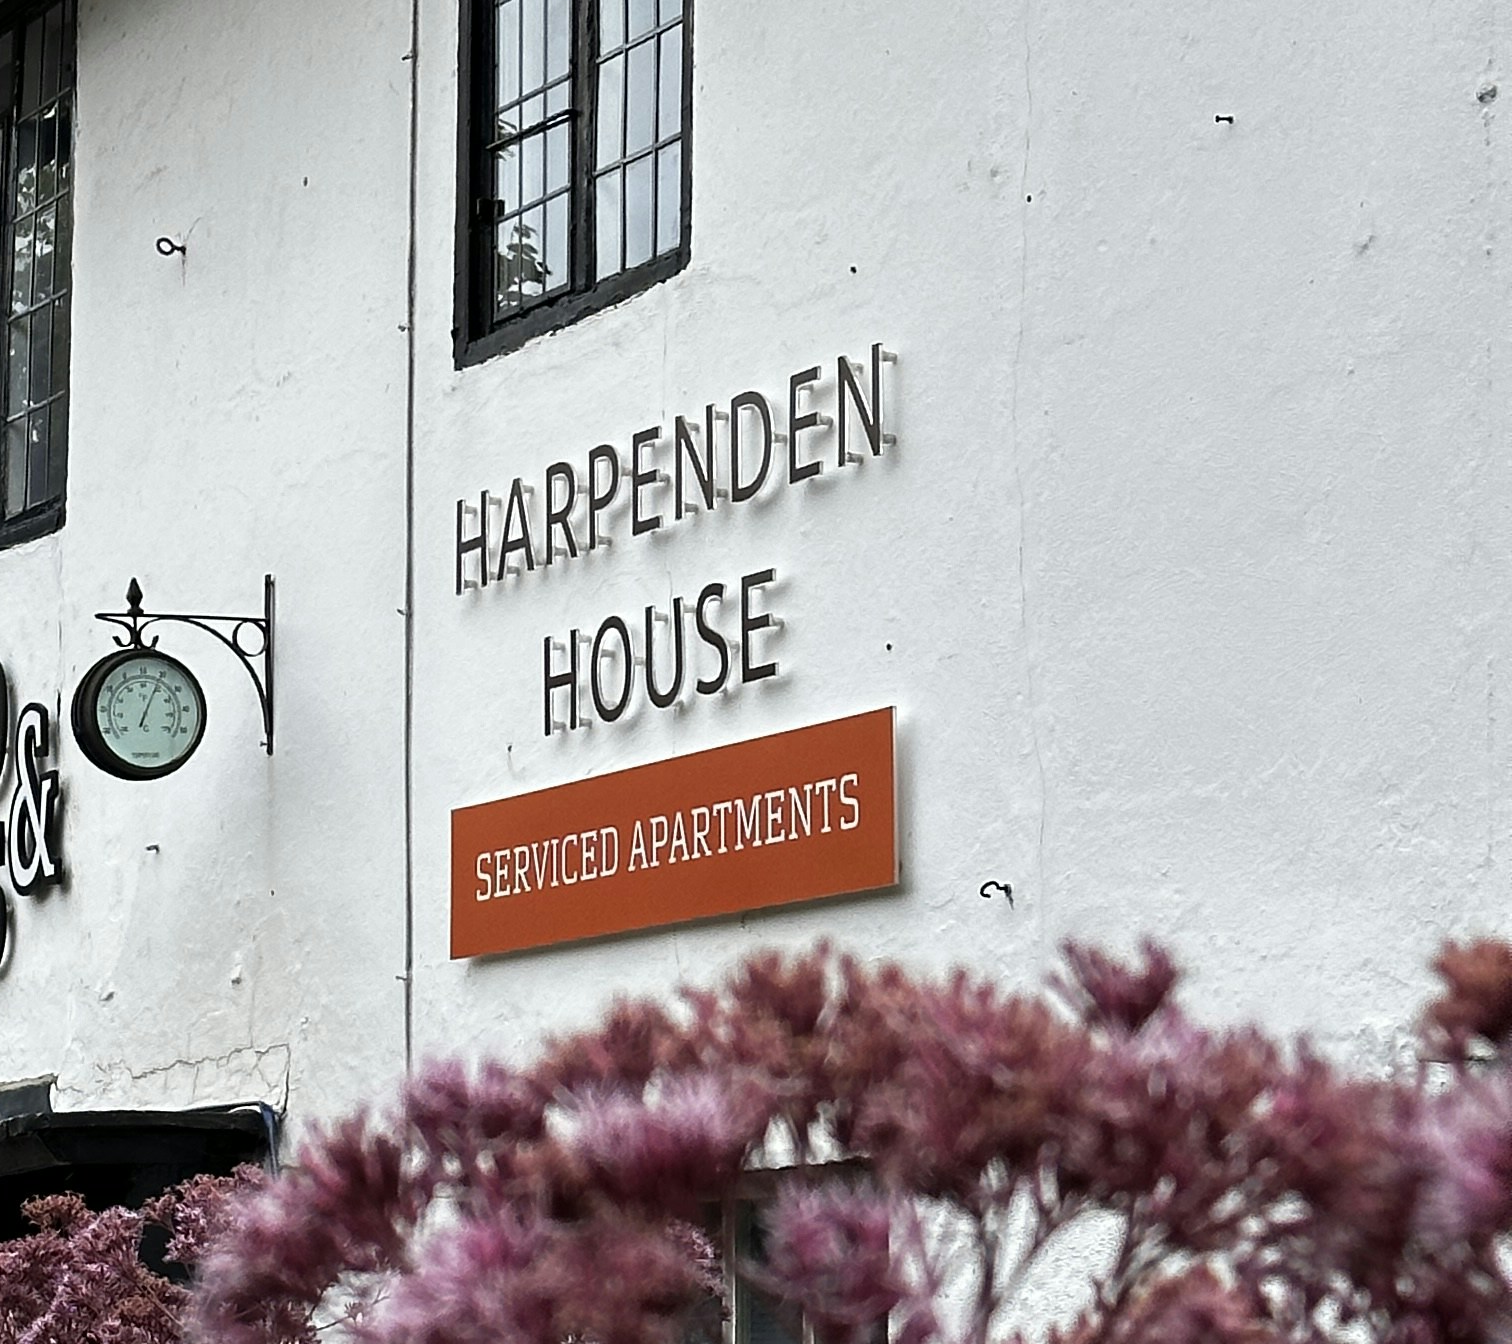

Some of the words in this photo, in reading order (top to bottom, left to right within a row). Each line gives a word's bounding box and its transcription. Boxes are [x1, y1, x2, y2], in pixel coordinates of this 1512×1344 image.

[455, 343, 890, 595] HARPENDEN
[543, 568, 779, 735] HOUSE
[8, 702, 62, 896] &
[476, 826, 619, 902] SERVICED
[628, 773, 860, 872] APARTMENTS
